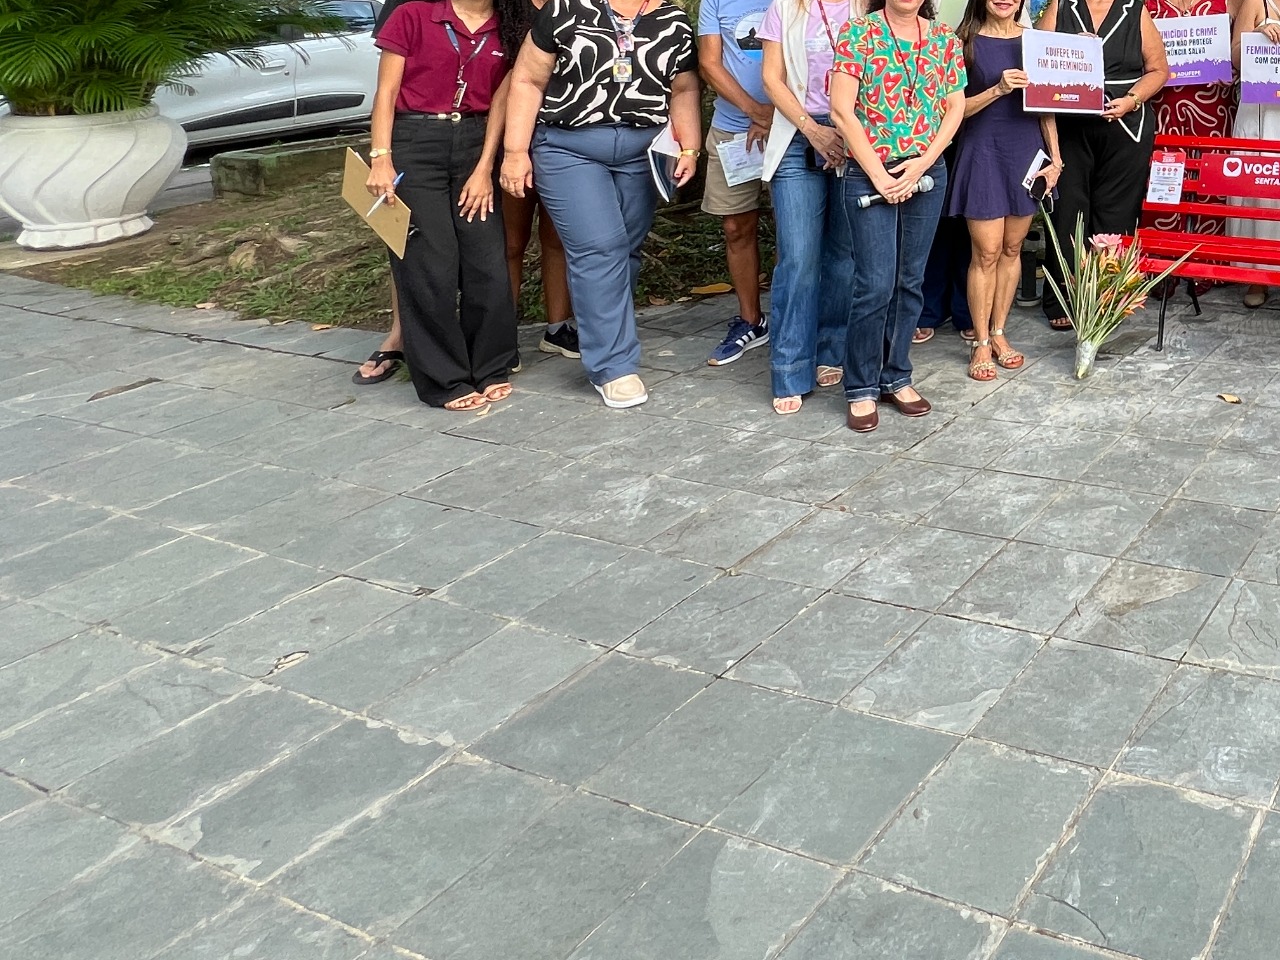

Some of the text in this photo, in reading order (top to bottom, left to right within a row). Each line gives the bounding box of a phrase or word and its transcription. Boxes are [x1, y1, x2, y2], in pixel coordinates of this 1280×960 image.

[1190, 28, 1194, 36] É
[1196, 27, 1217, 36] CRIME
[1177, 39, 1187, 47] NÃO
[1046, 47, 1084, 59] ADUFEPE PELO
[1038, 59, 1092, 72] FIM DO FEMINICÍDIO
[1243, 162, 1279, 176] VOCÊ
